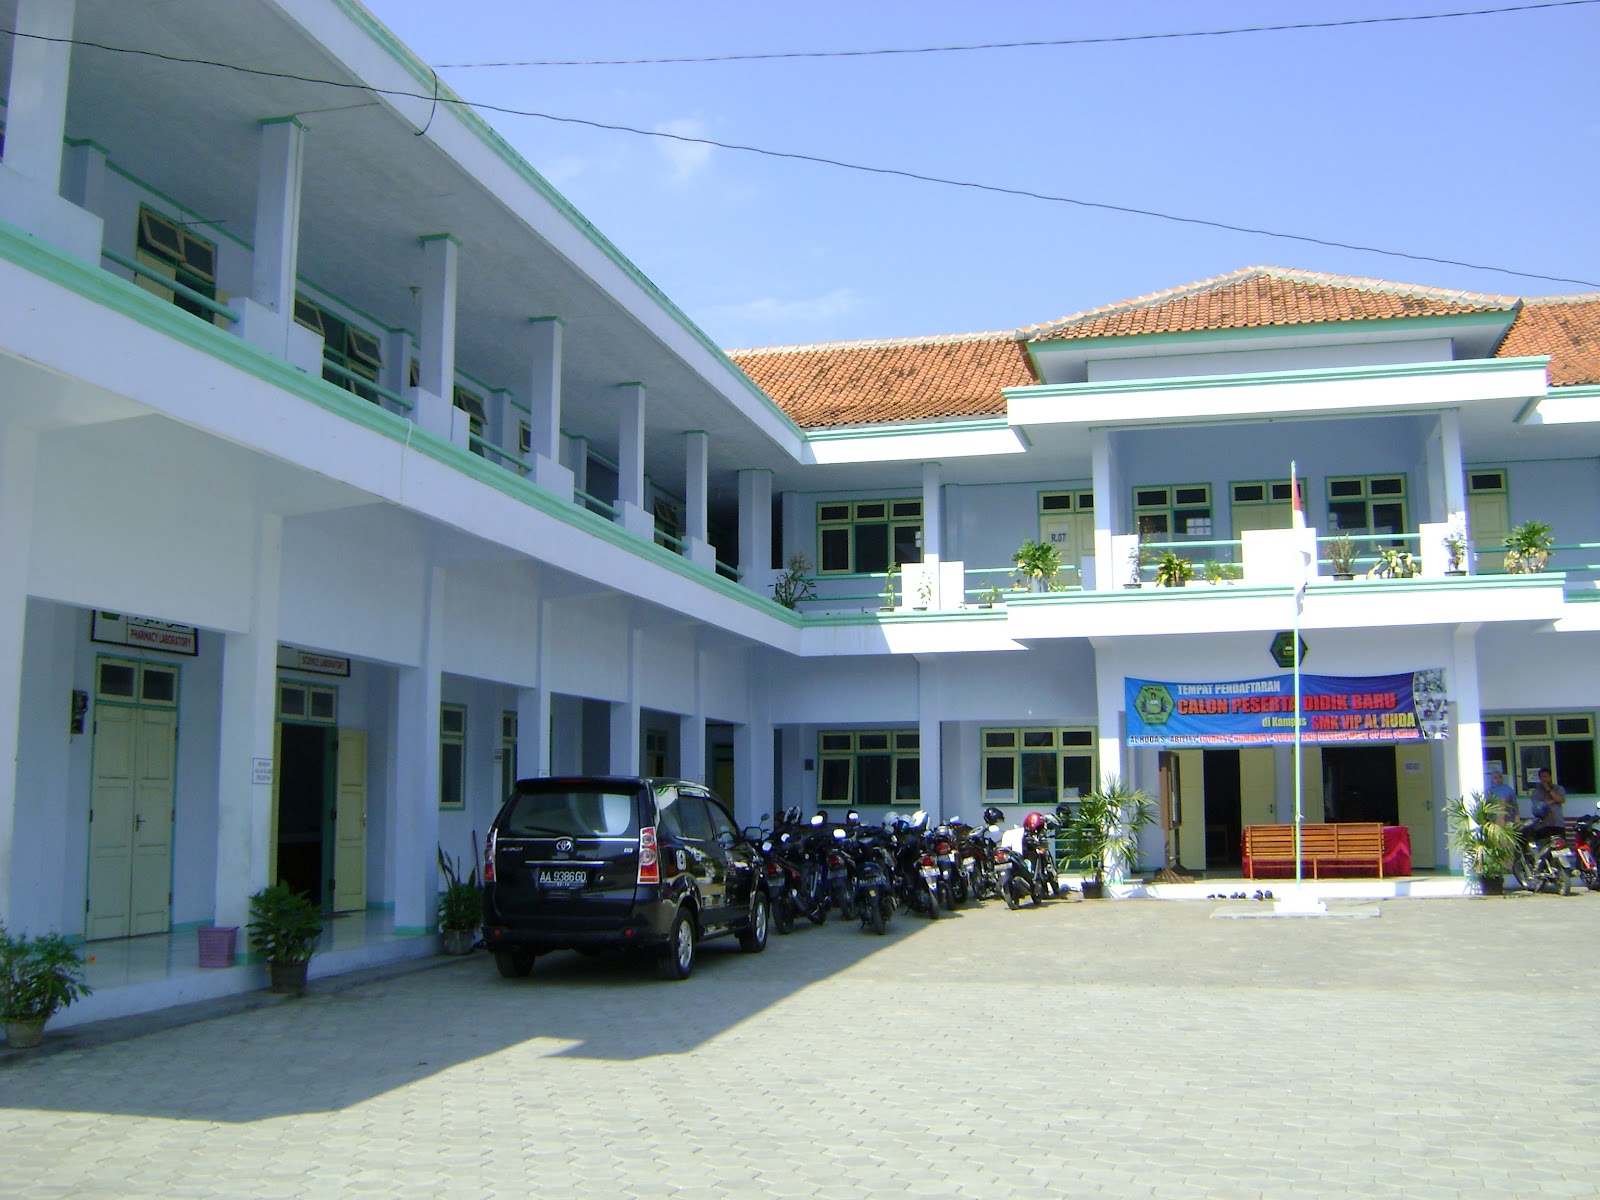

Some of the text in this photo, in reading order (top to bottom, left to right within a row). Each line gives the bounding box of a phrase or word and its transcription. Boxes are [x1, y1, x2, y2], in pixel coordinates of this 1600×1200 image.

[130, 628, 191, 647] PHARMACY LABORATORY
[1177, 684, 1213, 695] TEMPAT
[1215, 681, 1281, 694] PENDAFTARAN
[1177, 698, 1229, 714] CALON
[1303, 694, 1348, 711] DIDIK
[1352, 692, 1397, 710] BARU
[1262, 717, 1271, 728] di
[1311, 715, 1339, 730] SMK
[1341, 714, 1362, 729] VIP
[1364, 713, 1379, 729] AL
[1381, 712, 1416, 728] HUDA
[540, 872, 551, 882] AA
